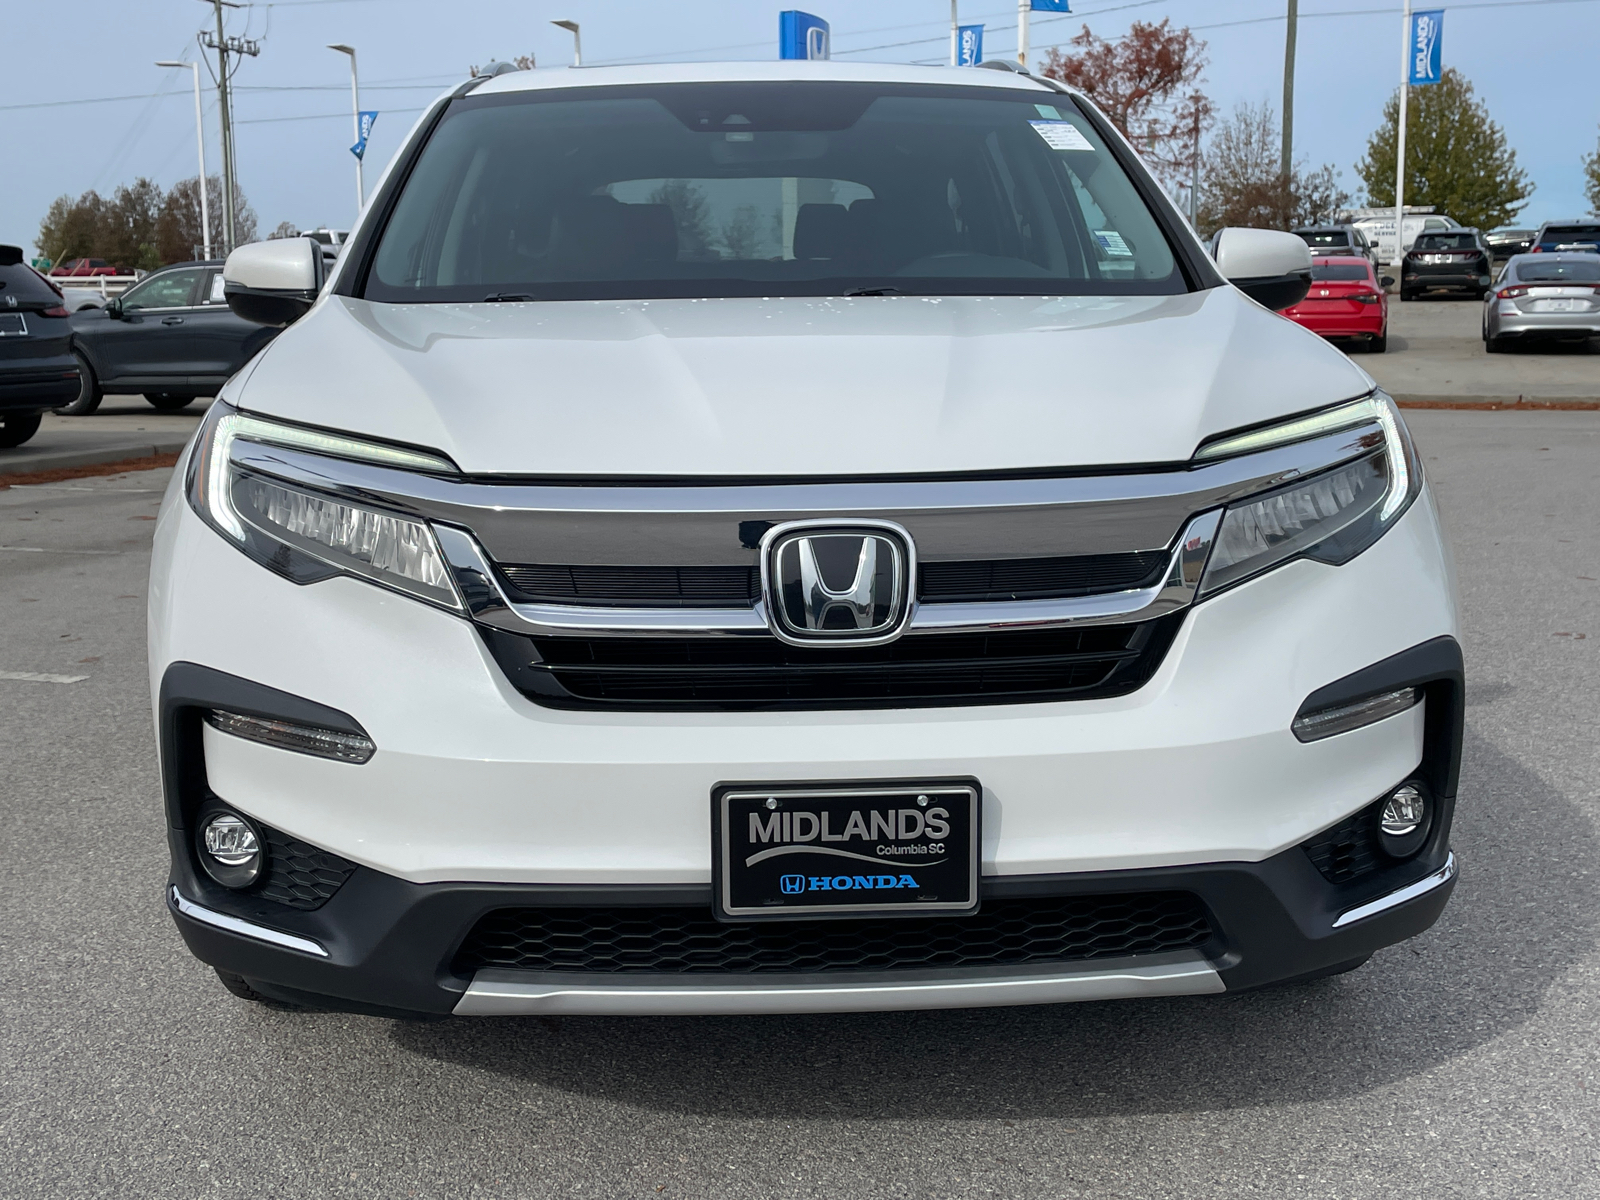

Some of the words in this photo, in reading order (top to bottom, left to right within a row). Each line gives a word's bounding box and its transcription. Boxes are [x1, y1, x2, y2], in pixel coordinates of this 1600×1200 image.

[1415, 16, 1429, 78] MIDLANDS
[748, 807, 950, 844] MIDLANDS
[876, 844, 928, 856] Columbia
[928, 843, 945, 854] SC
[808, 874, 920, 891] HONDA
